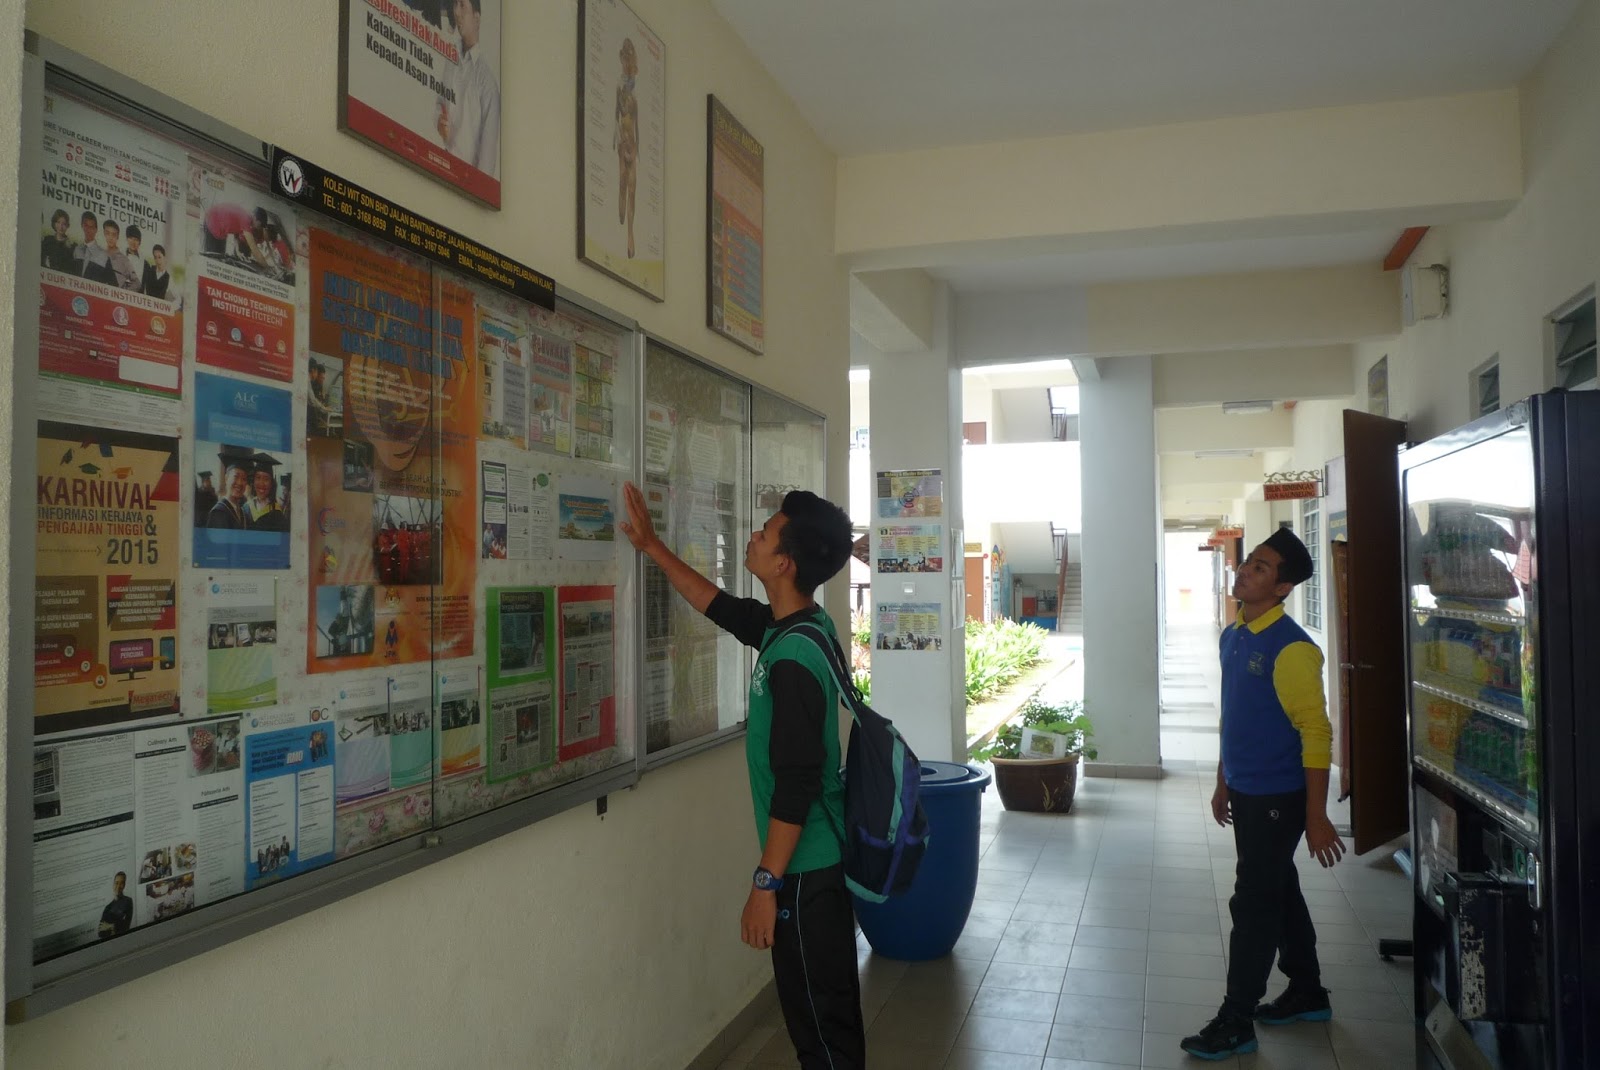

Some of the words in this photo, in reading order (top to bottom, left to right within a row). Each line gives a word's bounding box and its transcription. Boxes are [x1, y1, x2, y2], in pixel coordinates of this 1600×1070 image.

[366, 10, 407, 52] Katakan
[408, 39, 433, 70] Tidak
[433, 31, 459, 64] Anda
[366, 32, 403, 71] Kepada
[405, 59, 428, 87] Asap
[429, 74, 456, 105] Rokok
[58, 126, 76, 138] YOUR
[76, 132, 102, 148] CAREER
[102, 143, 118, 155] WITH
[119, 150, 130, 160] TAN
[131, 155, 152, 169] CHONG
[152, 163, 171, 176] GROUP
[41, 183, 106, 216] INSTITUTE
[55, 164, 73, 176] YOUR
[74, 170, 92, 183] FIRST
[93, 176, 109, 189] STEP
[109, 182, 132, 198] STARTS
[132, 191, 149, 203] WITH
[60, 176, 103, 200] CHONG
[105, 192, 167, 224] TECHNICAL
[323, 175, 347, 196] KOLEJ
[347, 186, 360, 202] WIT
[360, 193, 375, 209] SDN
[375, 200, 389, 216] BHD
[389, 208, 410, 226] JALAN
[409, 216, 435, 237] BANTING
[435, 227, 447, 241] OFF
[447, 234, 465, 251] JALAN
[323, 192, 336, 210] TEL
[341, 201, 352, 217] 603
[356, 208, 372, 225] 3168
[394, 225, 407, 240] FAX
[410, 232, 421, 247] 603
[458, 254, 475, 270] EMAIL
[47, 272, 66, 285] OUR
[68, 277, 109, 297] TRAINING
[111, 289, 152, 308] INSTITUTE
[153, 302, 172, 313] NOW
[206, 286, 223, 298] TAN
[223, 290, 249, 306] CHONG
[250, 299, 289, 319] TECHNICAL
[211, 298, 251, 318] INSTITUTE
[234, 391, 259, 404] ALC
[37, 475, 157, 511] KARNIVAL
[37, 506, 98, 522] INFORMASI
[101, 510, 143, 523] KERJAYA
[37, 520, 103, 535] PENGAJIAN
[108, 522, 143, 536] TINGGI
[144, 514, 157, 536] &
[106, 538, 158, 565] 2015
[147, 738, 168, 748] Culinary
